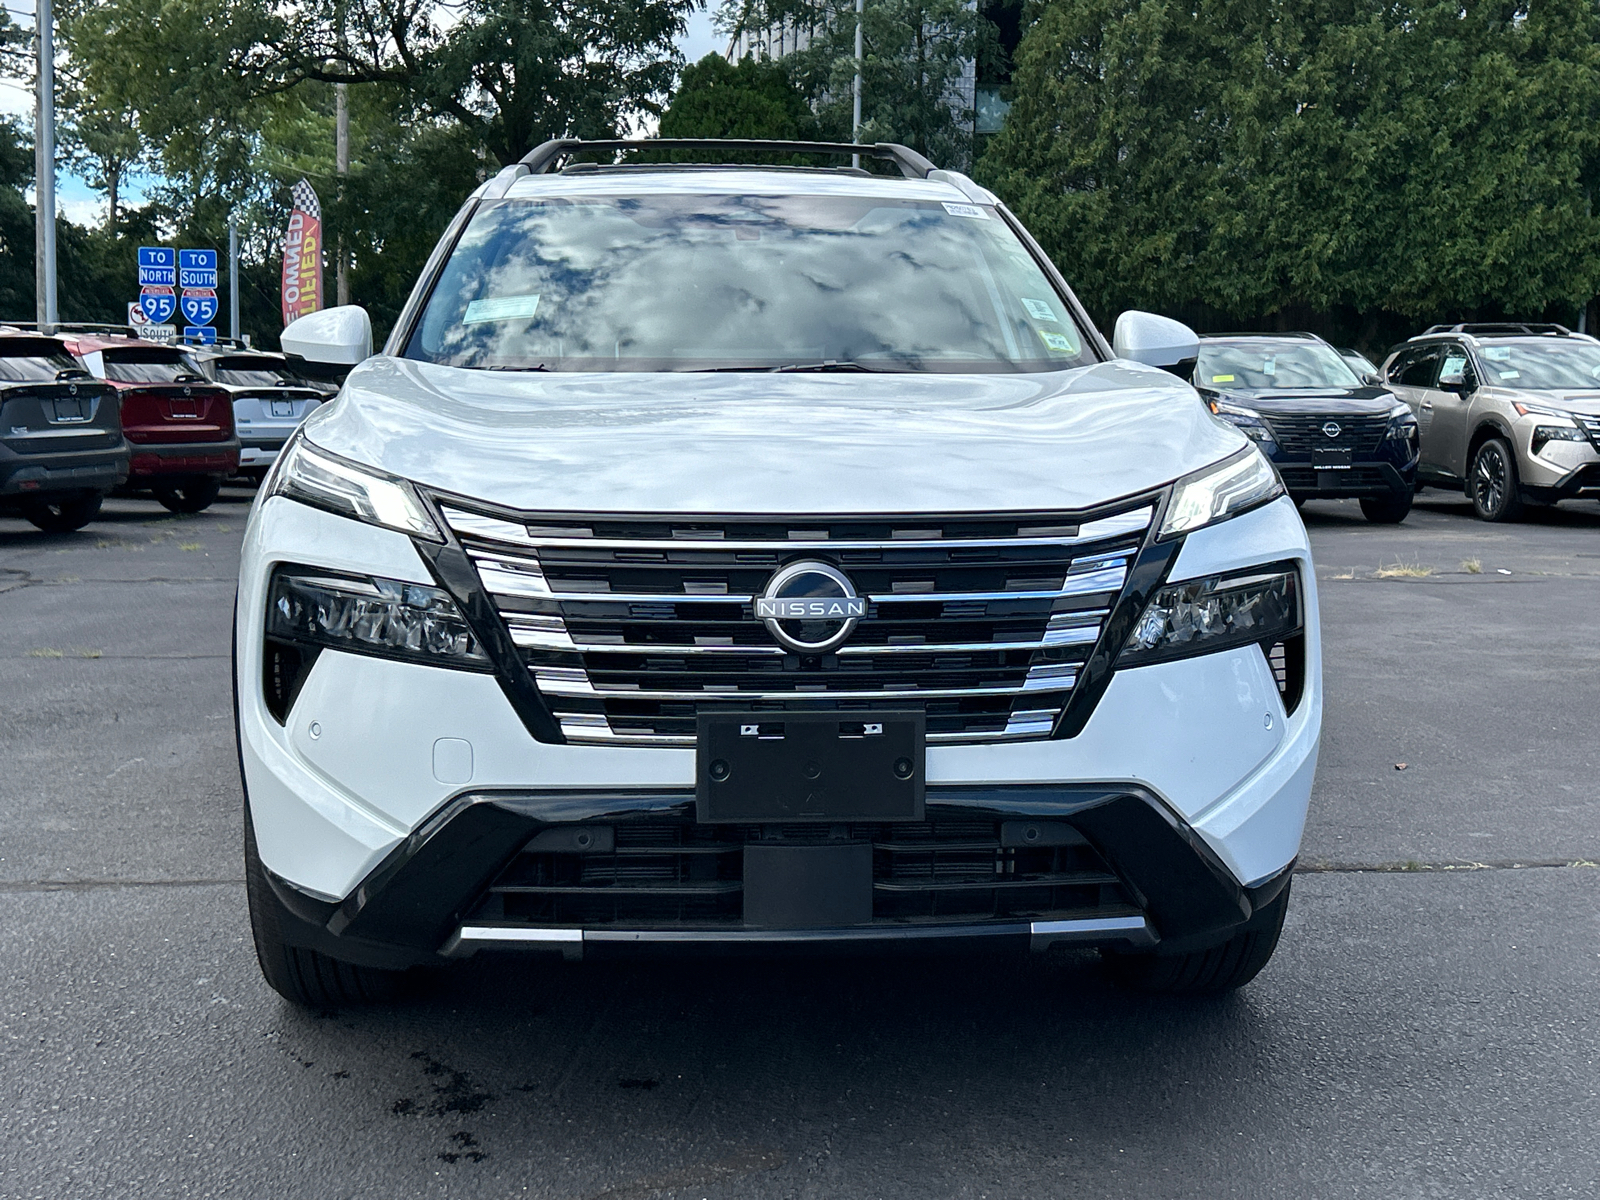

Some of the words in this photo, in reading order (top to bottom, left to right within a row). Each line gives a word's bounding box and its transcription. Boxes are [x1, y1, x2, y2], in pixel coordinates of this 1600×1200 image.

[148, 251, 166, 264] TO
[189, 253, 208, 266] TO
[141, 268, 174, 283] NORTH
[182, 271, 216, 285] SOUTH
[145, 298, 171, 317] 95
[186, 300, 213, 319] 95
[142, 327, 174, 340] SOUTH
[760, 602, 863, 616] NISSAN
